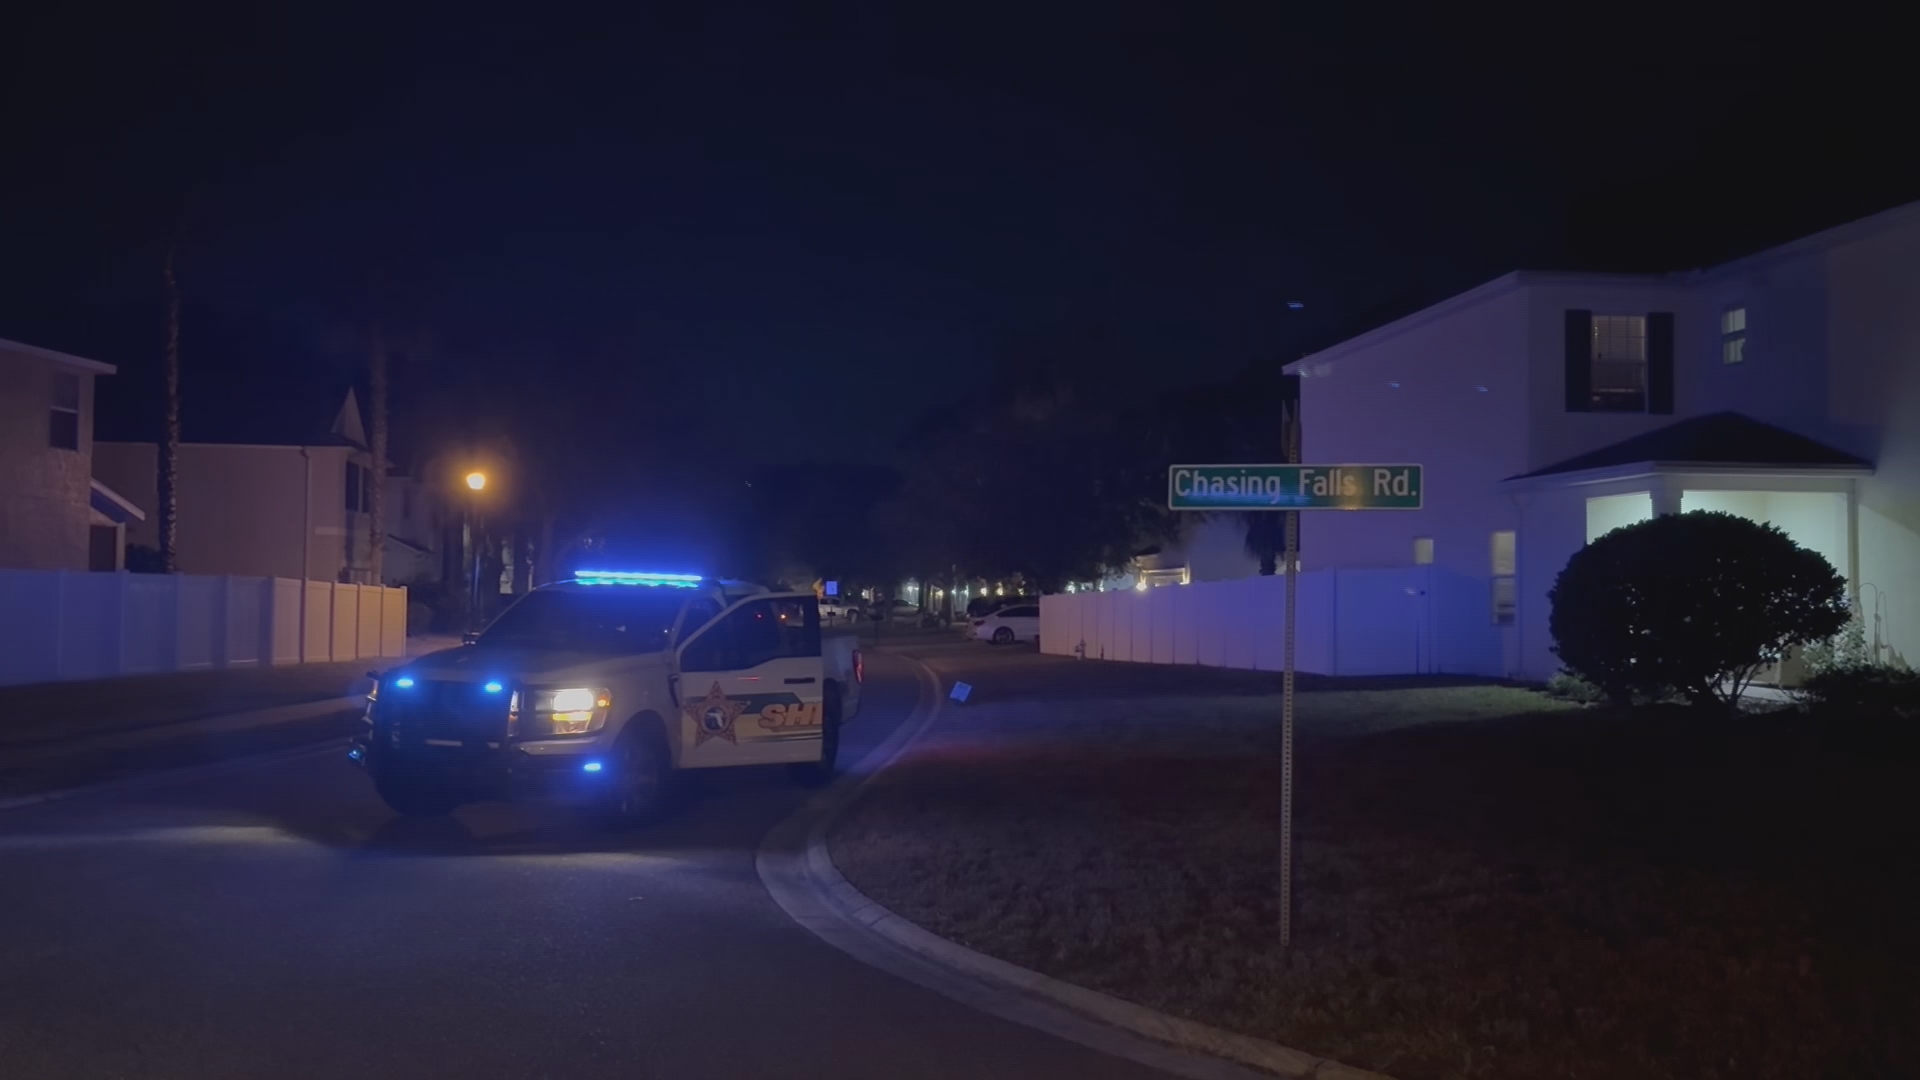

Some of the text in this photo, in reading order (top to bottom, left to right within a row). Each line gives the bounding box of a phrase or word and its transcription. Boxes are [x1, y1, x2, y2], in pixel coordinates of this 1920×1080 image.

[1174, 468, 1417, 504] Chasing Falls Rd.
